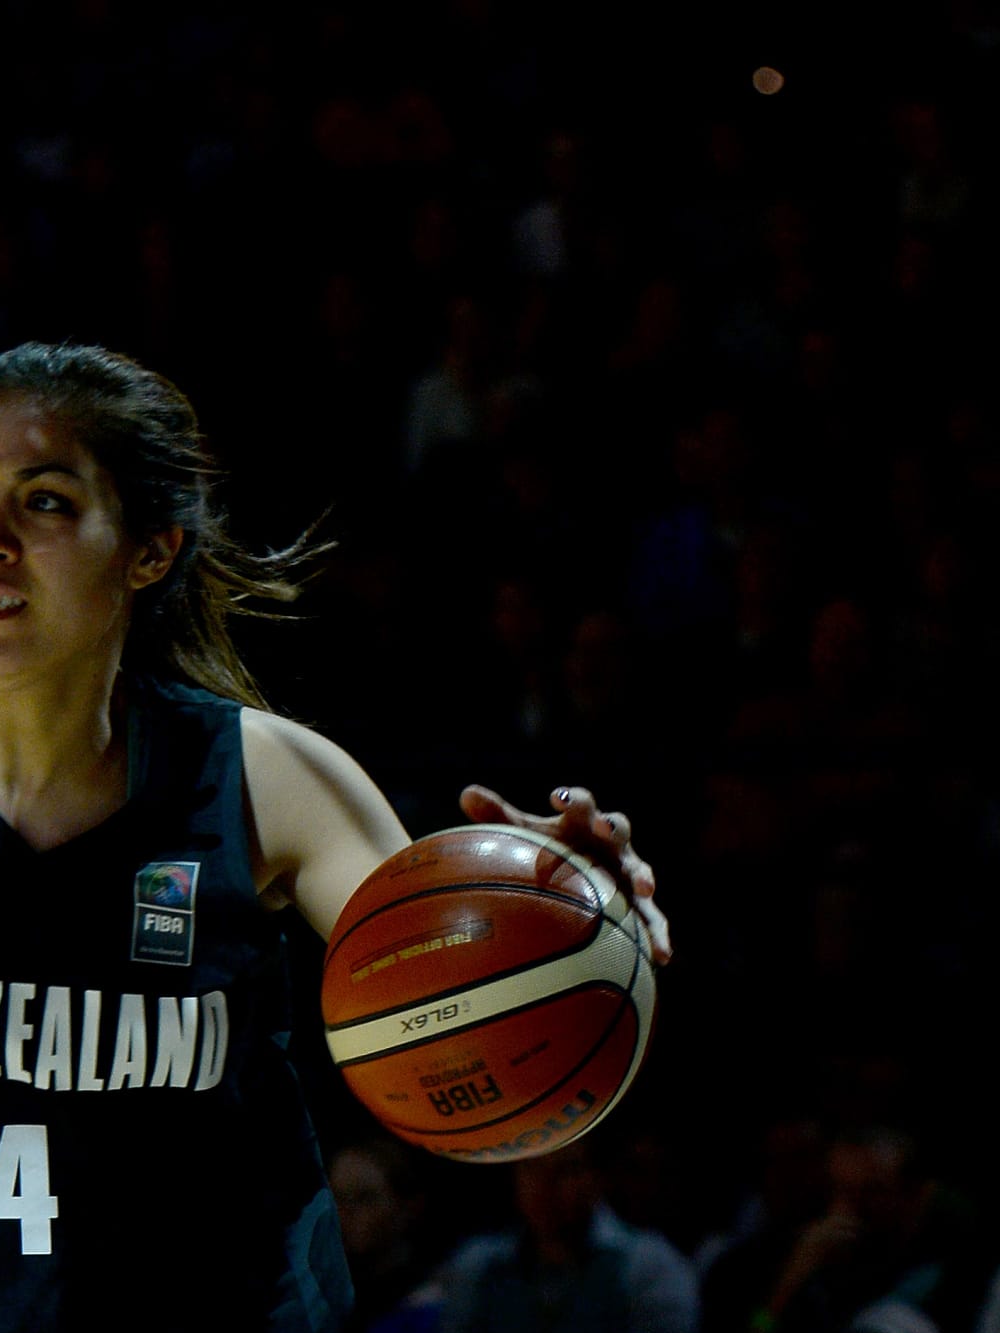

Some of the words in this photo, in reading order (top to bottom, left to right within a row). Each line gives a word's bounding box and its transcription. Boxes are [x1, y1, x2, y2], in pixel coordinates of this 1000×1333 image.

[143, 913, 184, 935] FIBA
[400, 1003, 459, 1034] GL6X
[428, 1074, 504, 1118] FIBA
